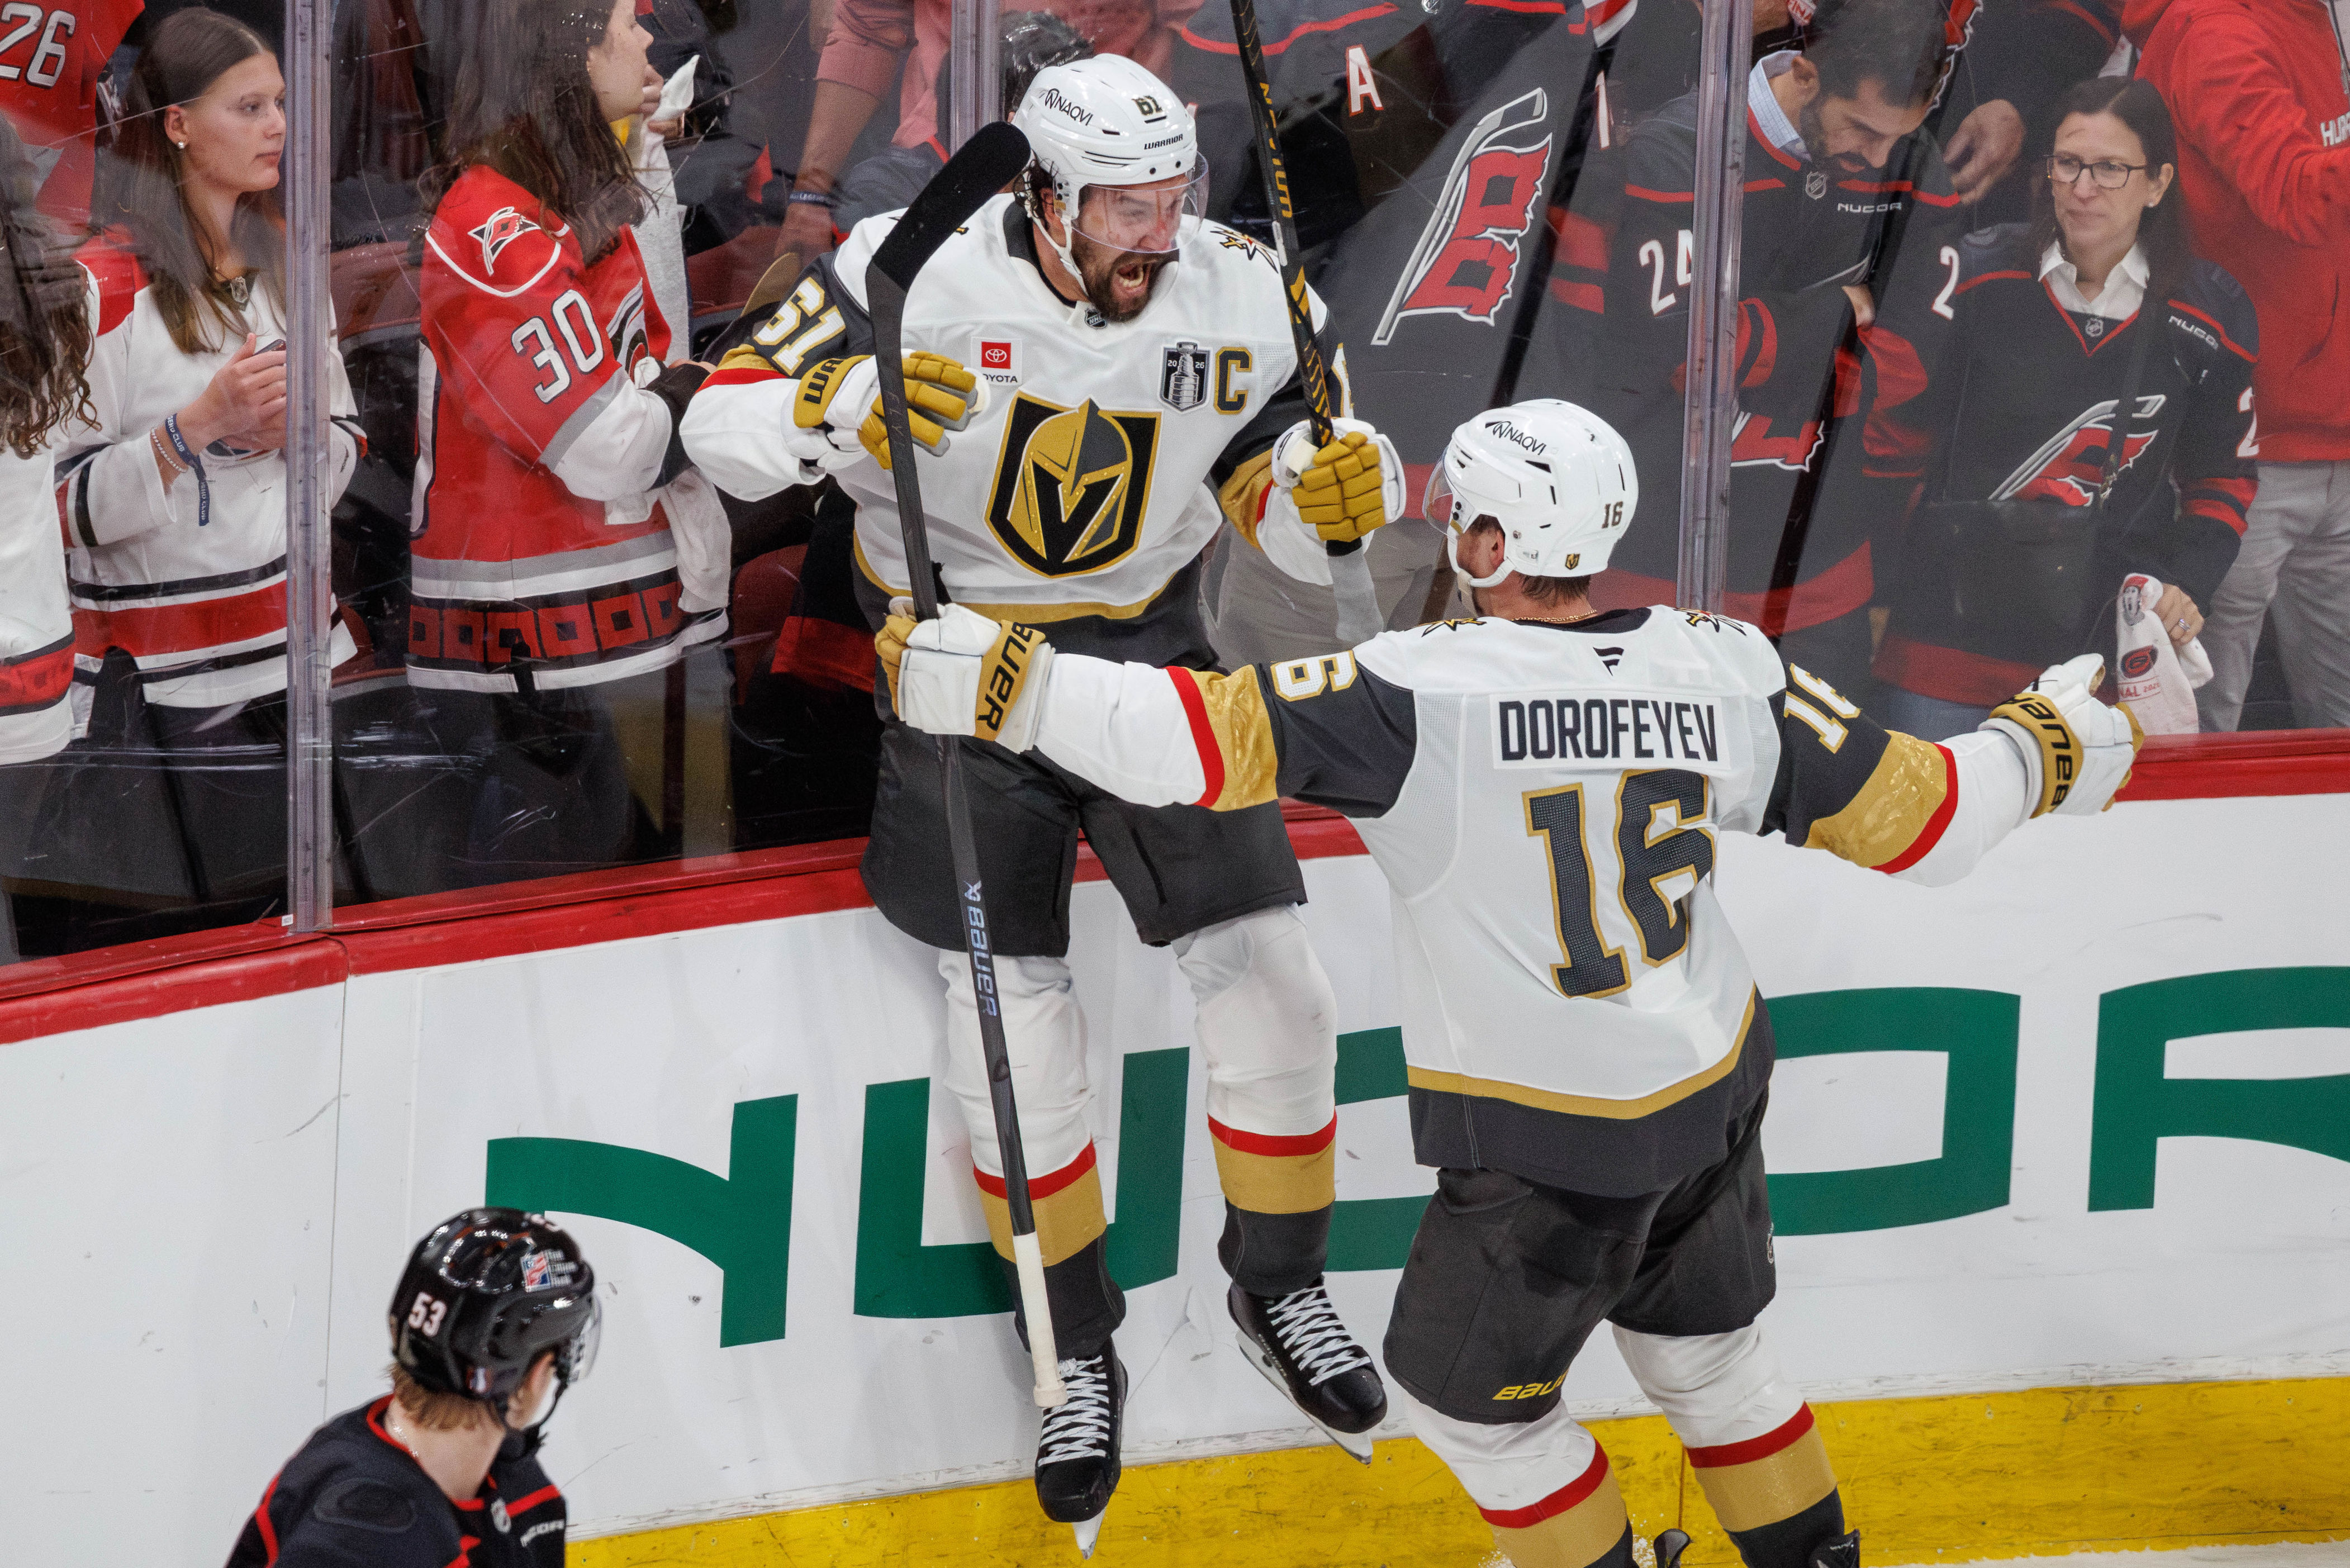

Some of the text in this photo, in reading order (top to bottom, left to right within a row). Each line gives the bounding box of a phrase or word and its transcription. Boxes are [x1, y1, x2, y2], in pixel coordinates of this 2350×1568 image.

[0, 2, 77, 90] 26
[1132, 95, 1163, 116] 61
[1345, 44, 1384, 116] A
[1144, 133, 1178, 150] WARRIOR
[1837, 202, 1902, 213] NUCOR
[511, 288, 604, 405] 30
[753, 277, 846, 377] 61
[1213, 346, 1252, 415] C
[172, 431, 185, 452] CLUB
[1504, 426, 1547, 455] NAQVI
[1602, 501, 1623, 529] 16
[1499, 699, 1718, 762] DOROFEYEV
[1521, 768, 1716, 999] 16
[967, 905, 997, 1017] BAUER
[408, 1291, 447, 1338] 53
[1492, 1369, 1569, 1400] BAU
